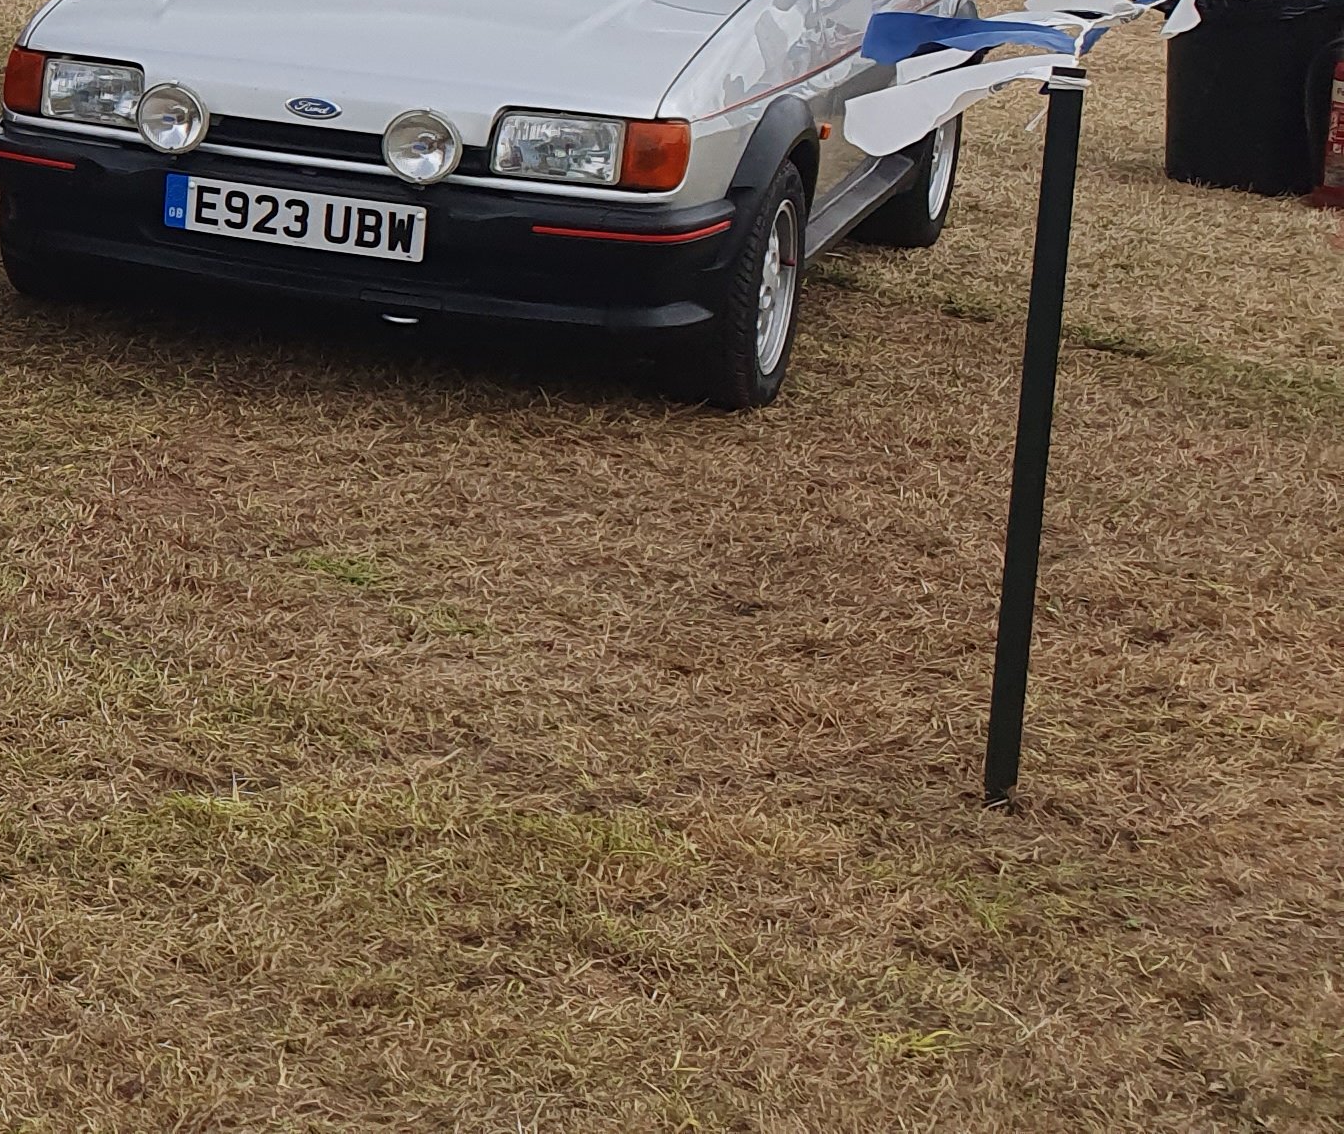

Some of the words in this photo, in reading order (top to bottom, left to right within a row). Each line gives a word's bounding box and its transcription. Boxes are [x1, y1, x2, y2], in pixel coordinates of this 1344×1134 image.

[293, 99, 331, 115] Ford
[168, 207, 184, 219] GB
[194, 184, 310, 239] E923
[323, 202, 416, 254] UBW
